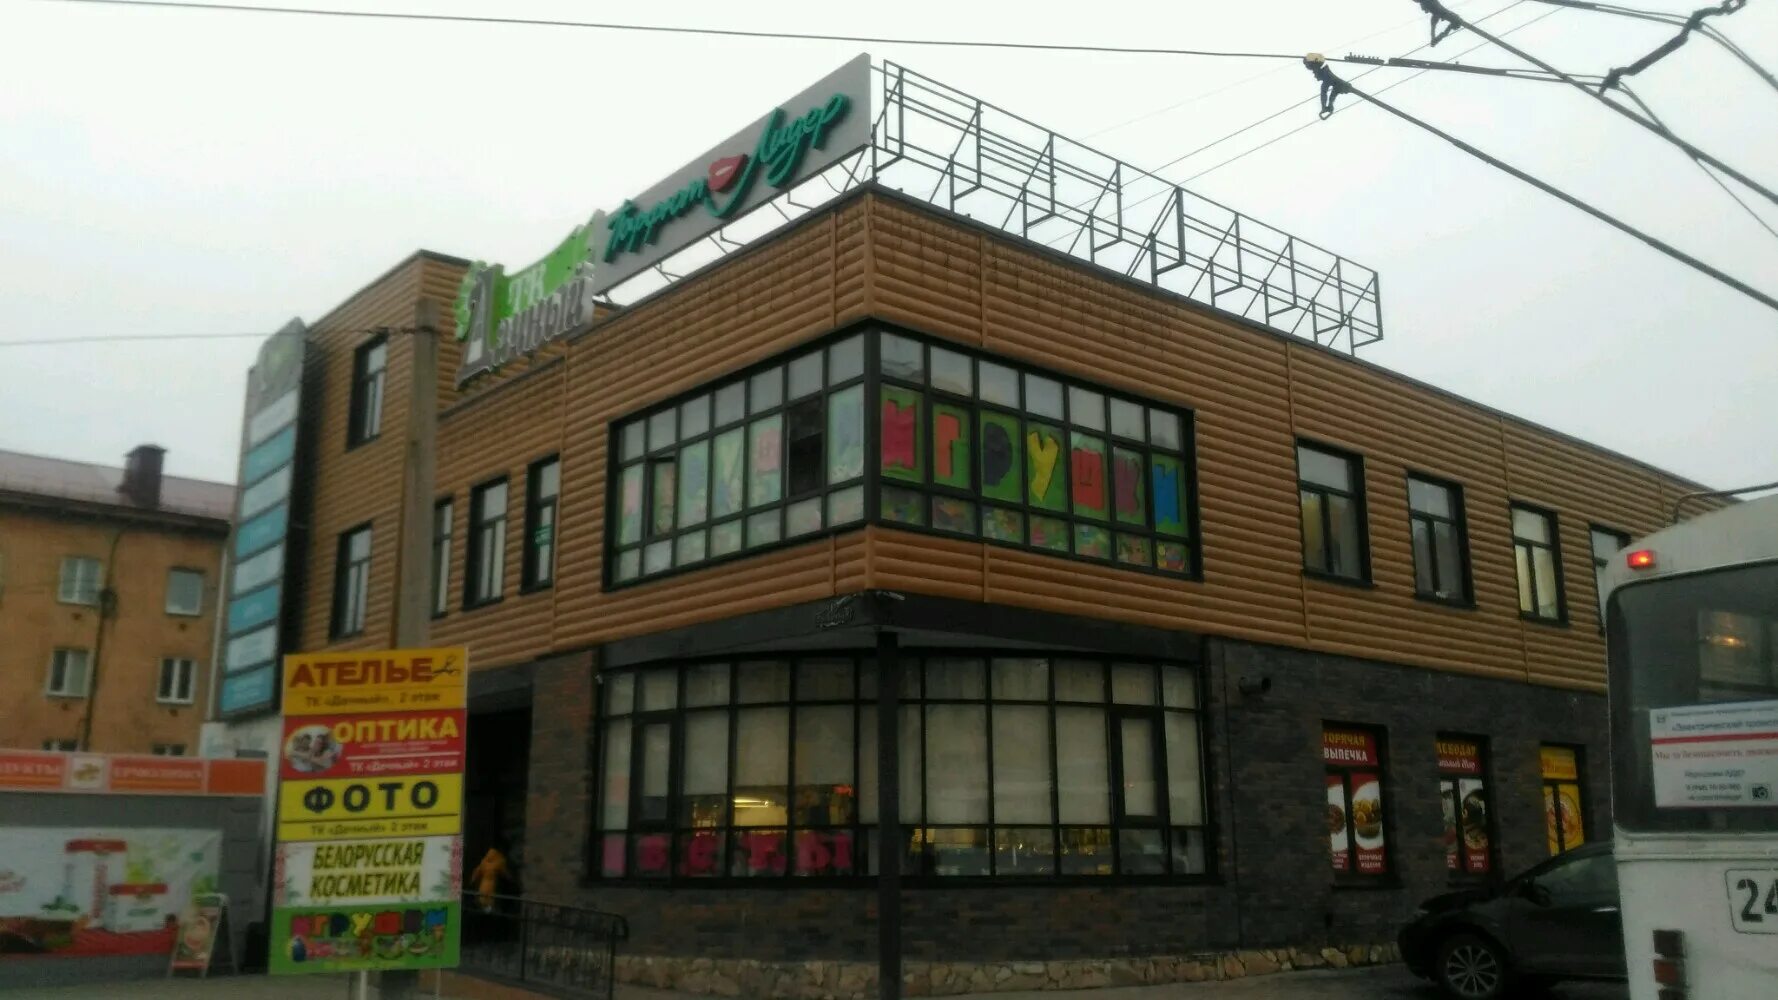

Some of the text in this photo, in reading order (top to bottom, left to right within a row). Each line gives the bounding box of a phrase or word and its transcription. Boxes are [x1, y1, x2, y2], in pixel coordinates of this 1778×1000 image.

[881, 399, 1180, 524] ИГРУШКИ
[289, 657, 434, 688] АТЕЛЬЕ
[334, 716, 458, 744] ОПТИКА
[1323, 730, 1365, 747] ГОРЯЧАЯ
[1323, 748, 1368, 762] ВЫПЕЧКА
[303, 781, 439, 814] ФОТО
[313, 842, 425, 871] БЕЛОРУССКАЯ
[310, 871, 422, 899] КОСМЕТИКА
